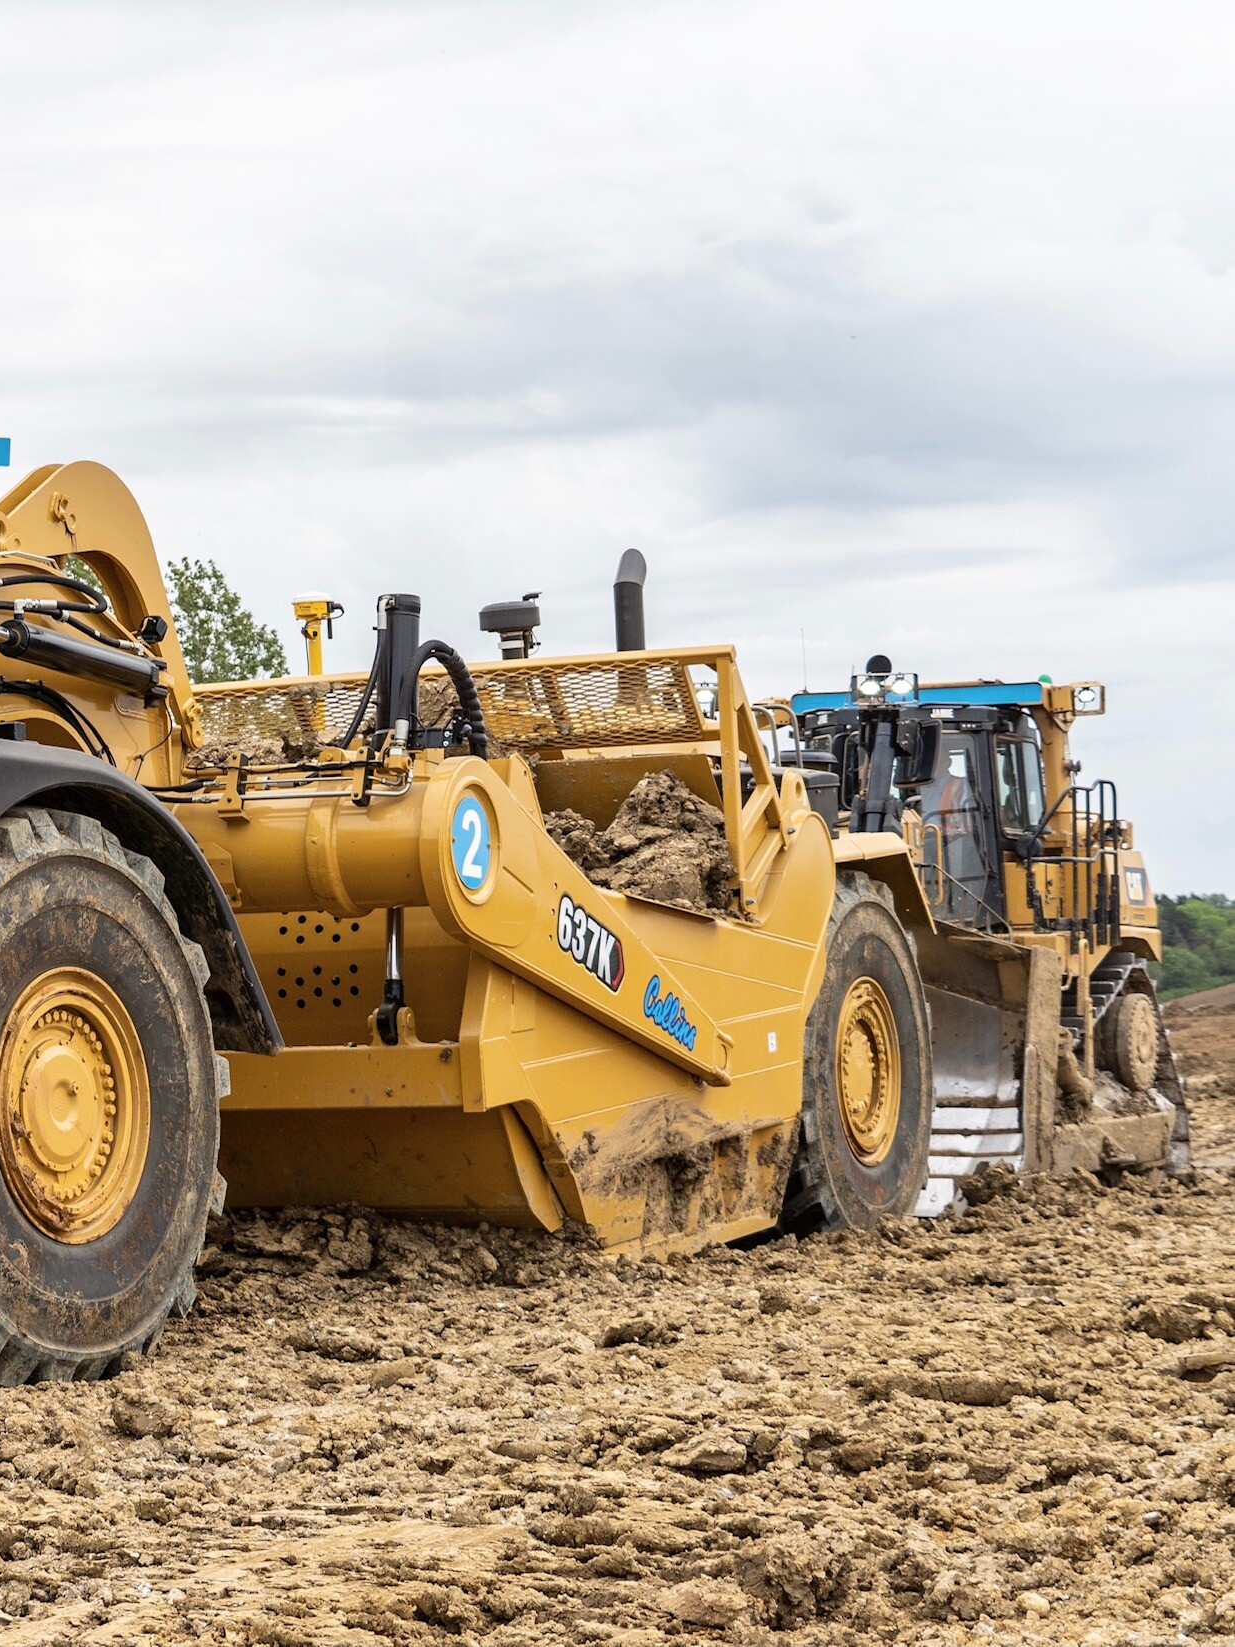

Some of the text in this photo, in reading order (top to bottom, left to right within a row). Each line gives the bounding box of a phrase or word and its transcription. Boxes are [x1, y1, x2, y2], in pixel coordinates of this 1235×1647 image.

[461, 809, 482, 879] 2
[558, 895, 616, 986] 637K
[643, 974, 697, 1050] Collins
